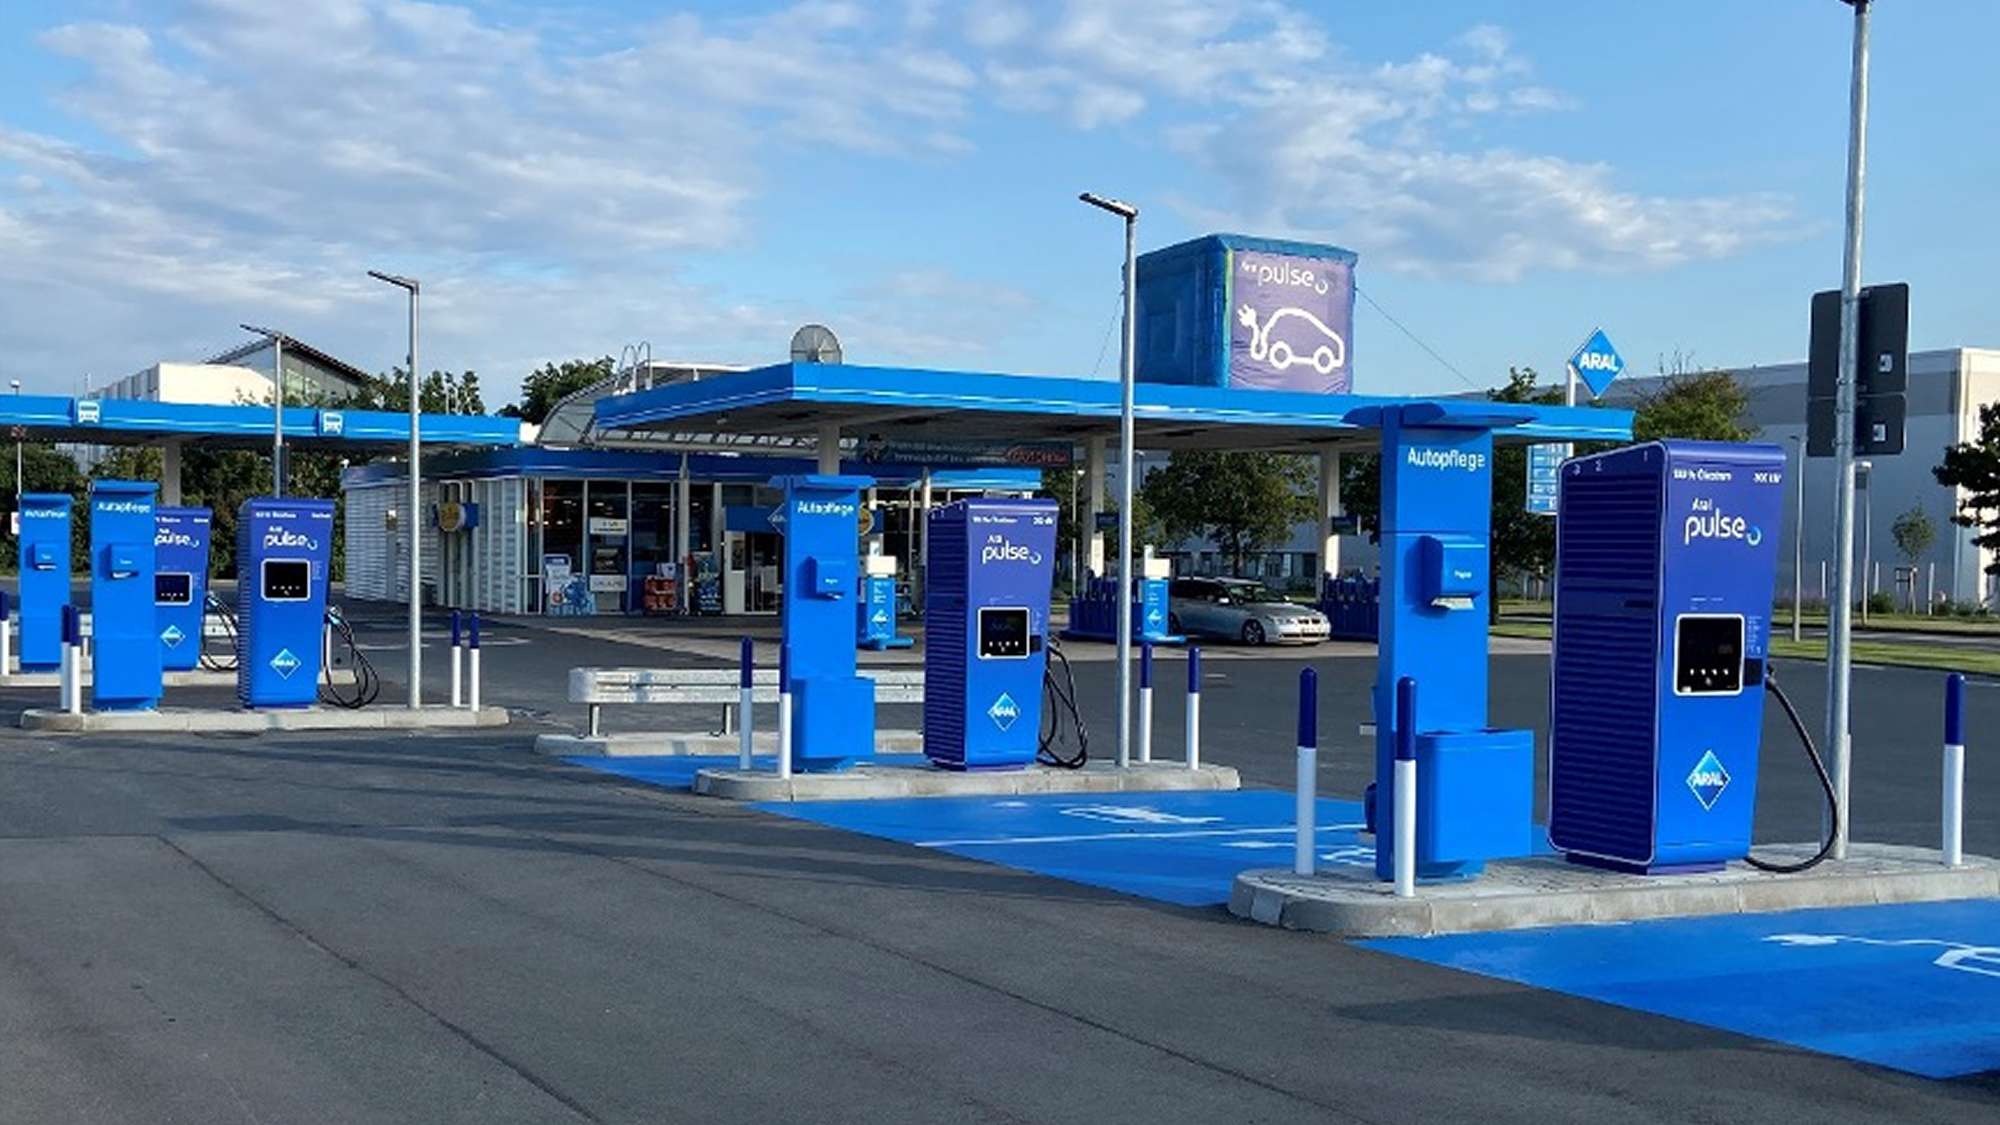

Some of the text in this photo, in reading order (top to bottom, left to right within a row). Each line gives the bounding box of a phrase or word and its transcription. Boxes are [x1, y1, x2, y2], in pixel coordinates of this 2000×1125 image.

[1258, 262, 1314, 287] pulse
[1579, 351, 1620, 372] ARAL
[1407, 446, 1486, 472] Autopflege
[1691, 497, 1713, 511] Aral
[1684, 507, 1746, 546] pulse
[263, 530, 308, 550] pulse
[982, 539, 1029, 565] pulse
[1692, 771, 1724, 786] ARAL
